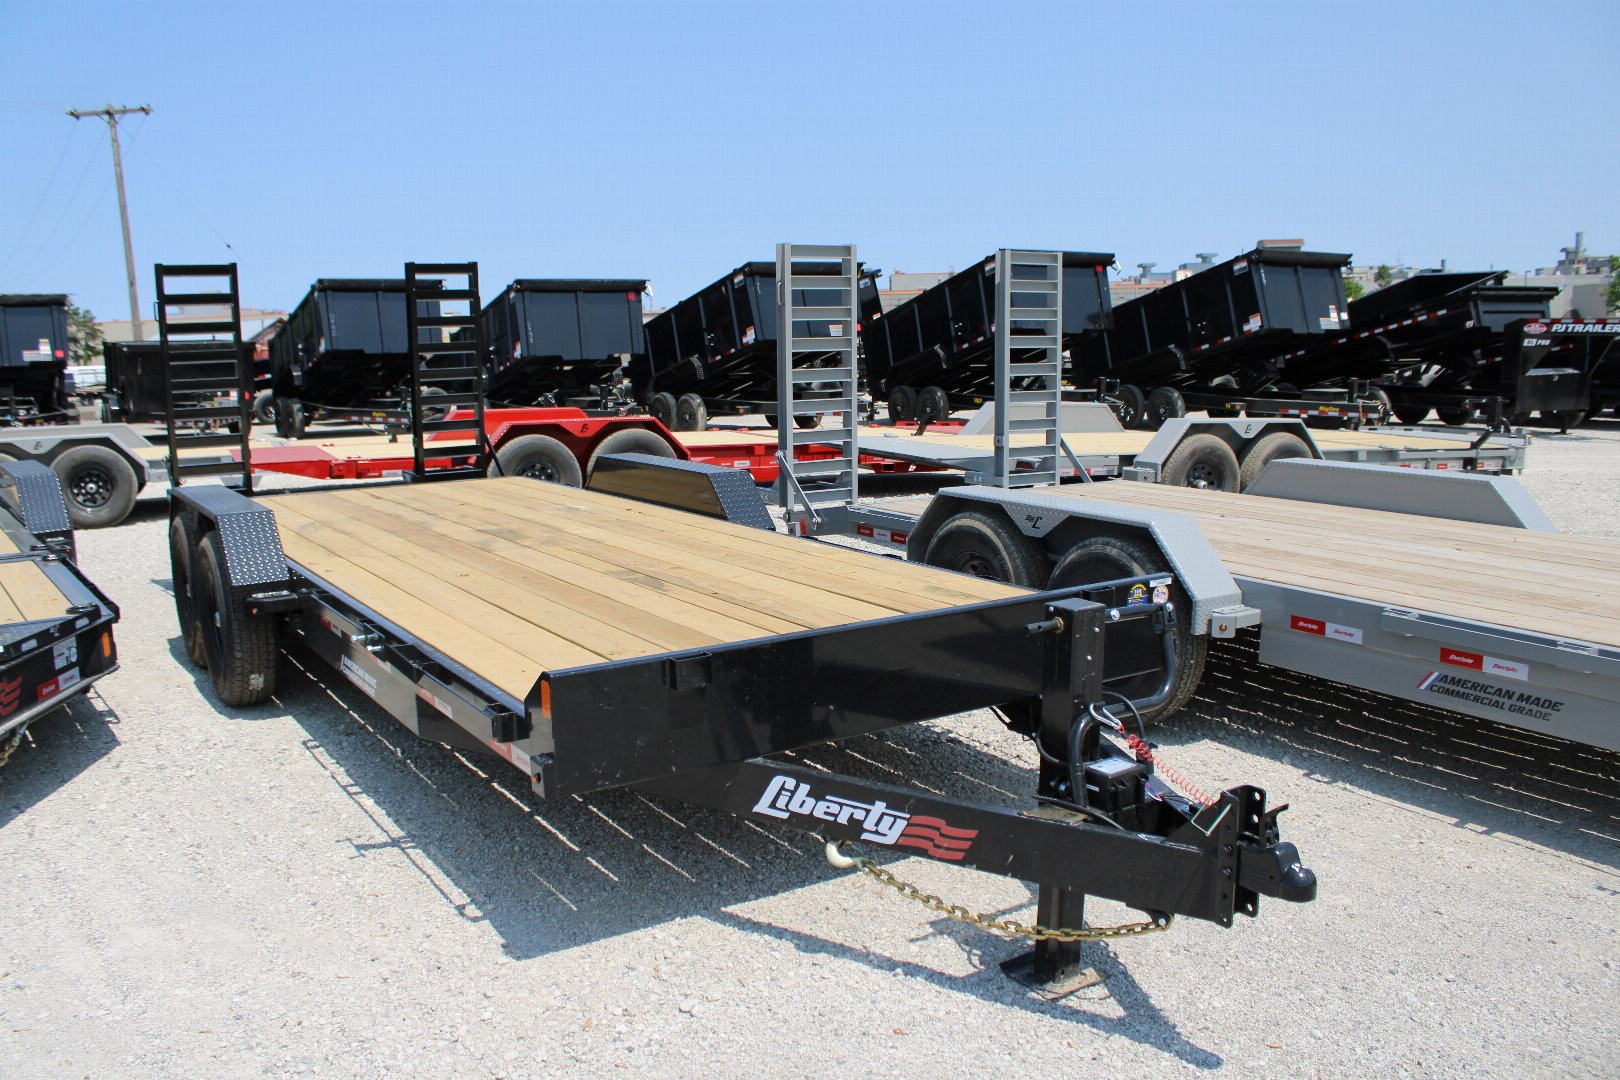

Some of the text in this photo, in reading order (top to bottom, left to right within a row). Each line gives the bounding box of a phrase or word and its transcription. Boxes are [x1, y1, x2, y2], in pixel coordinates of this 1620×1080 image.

[1429, 684, 1553, 722] COMMERCIAL GRADE
[1438, 674, 1564, 712] AMERICAN MADE
[752, 775, 911, 845] Liberty
